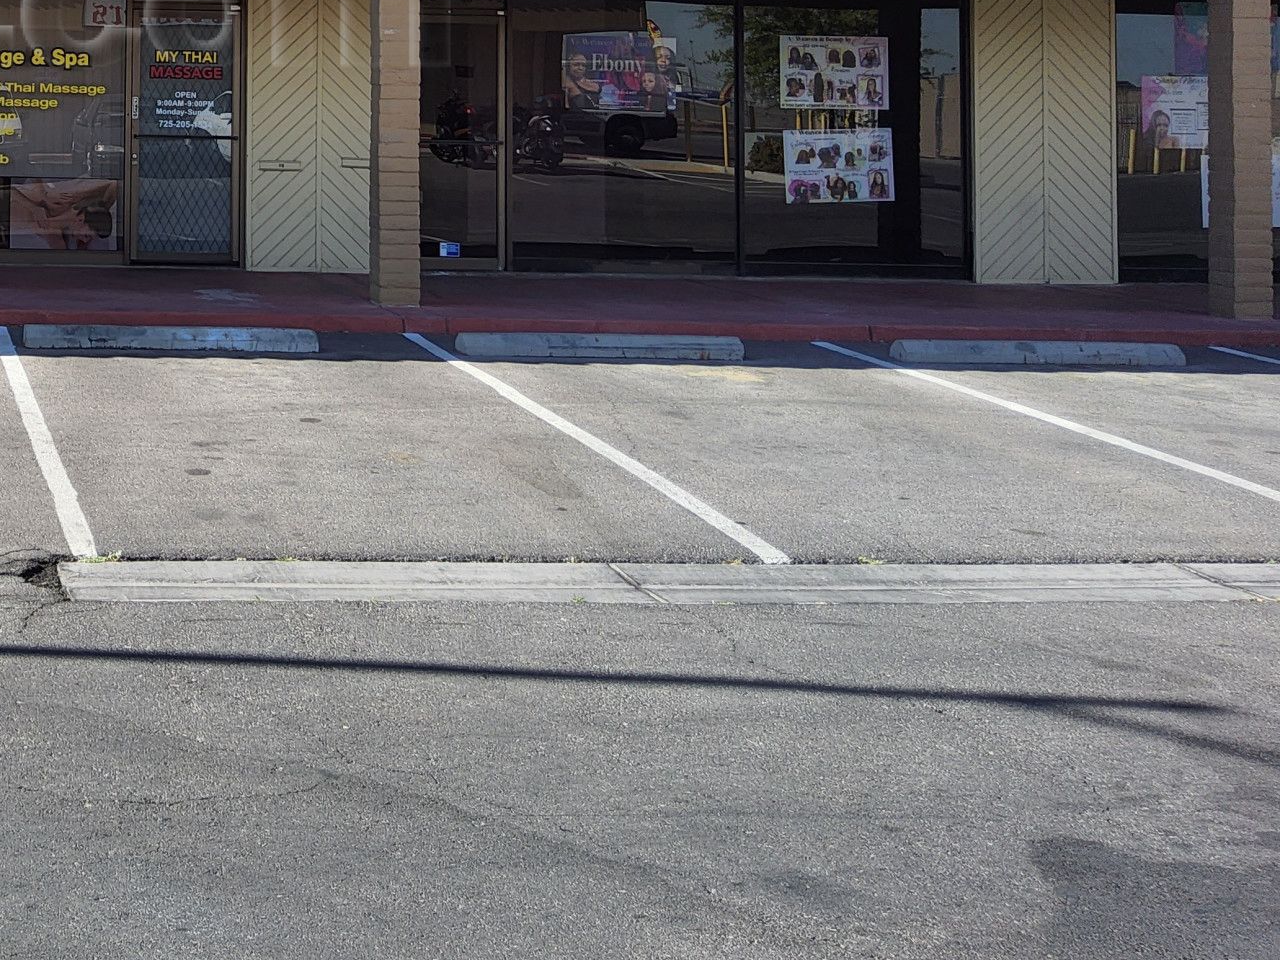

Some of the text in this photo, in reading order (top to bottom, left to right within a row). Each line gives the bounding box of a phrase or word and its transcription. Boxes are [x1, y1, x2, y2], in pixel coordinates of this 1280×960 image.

[31, 48, 45, 65] &
[52, 49, 89, 68] Spa
[156, 51, 217, 63] MY THAI
[592, 53, 645, 76] Ebony
[151, 66, 222, 79] MASSAGE
[6, 82, 35, 93] Thai
[40, 83, 106, 96] Massage
[175, 91, 197, 99] OPEN
